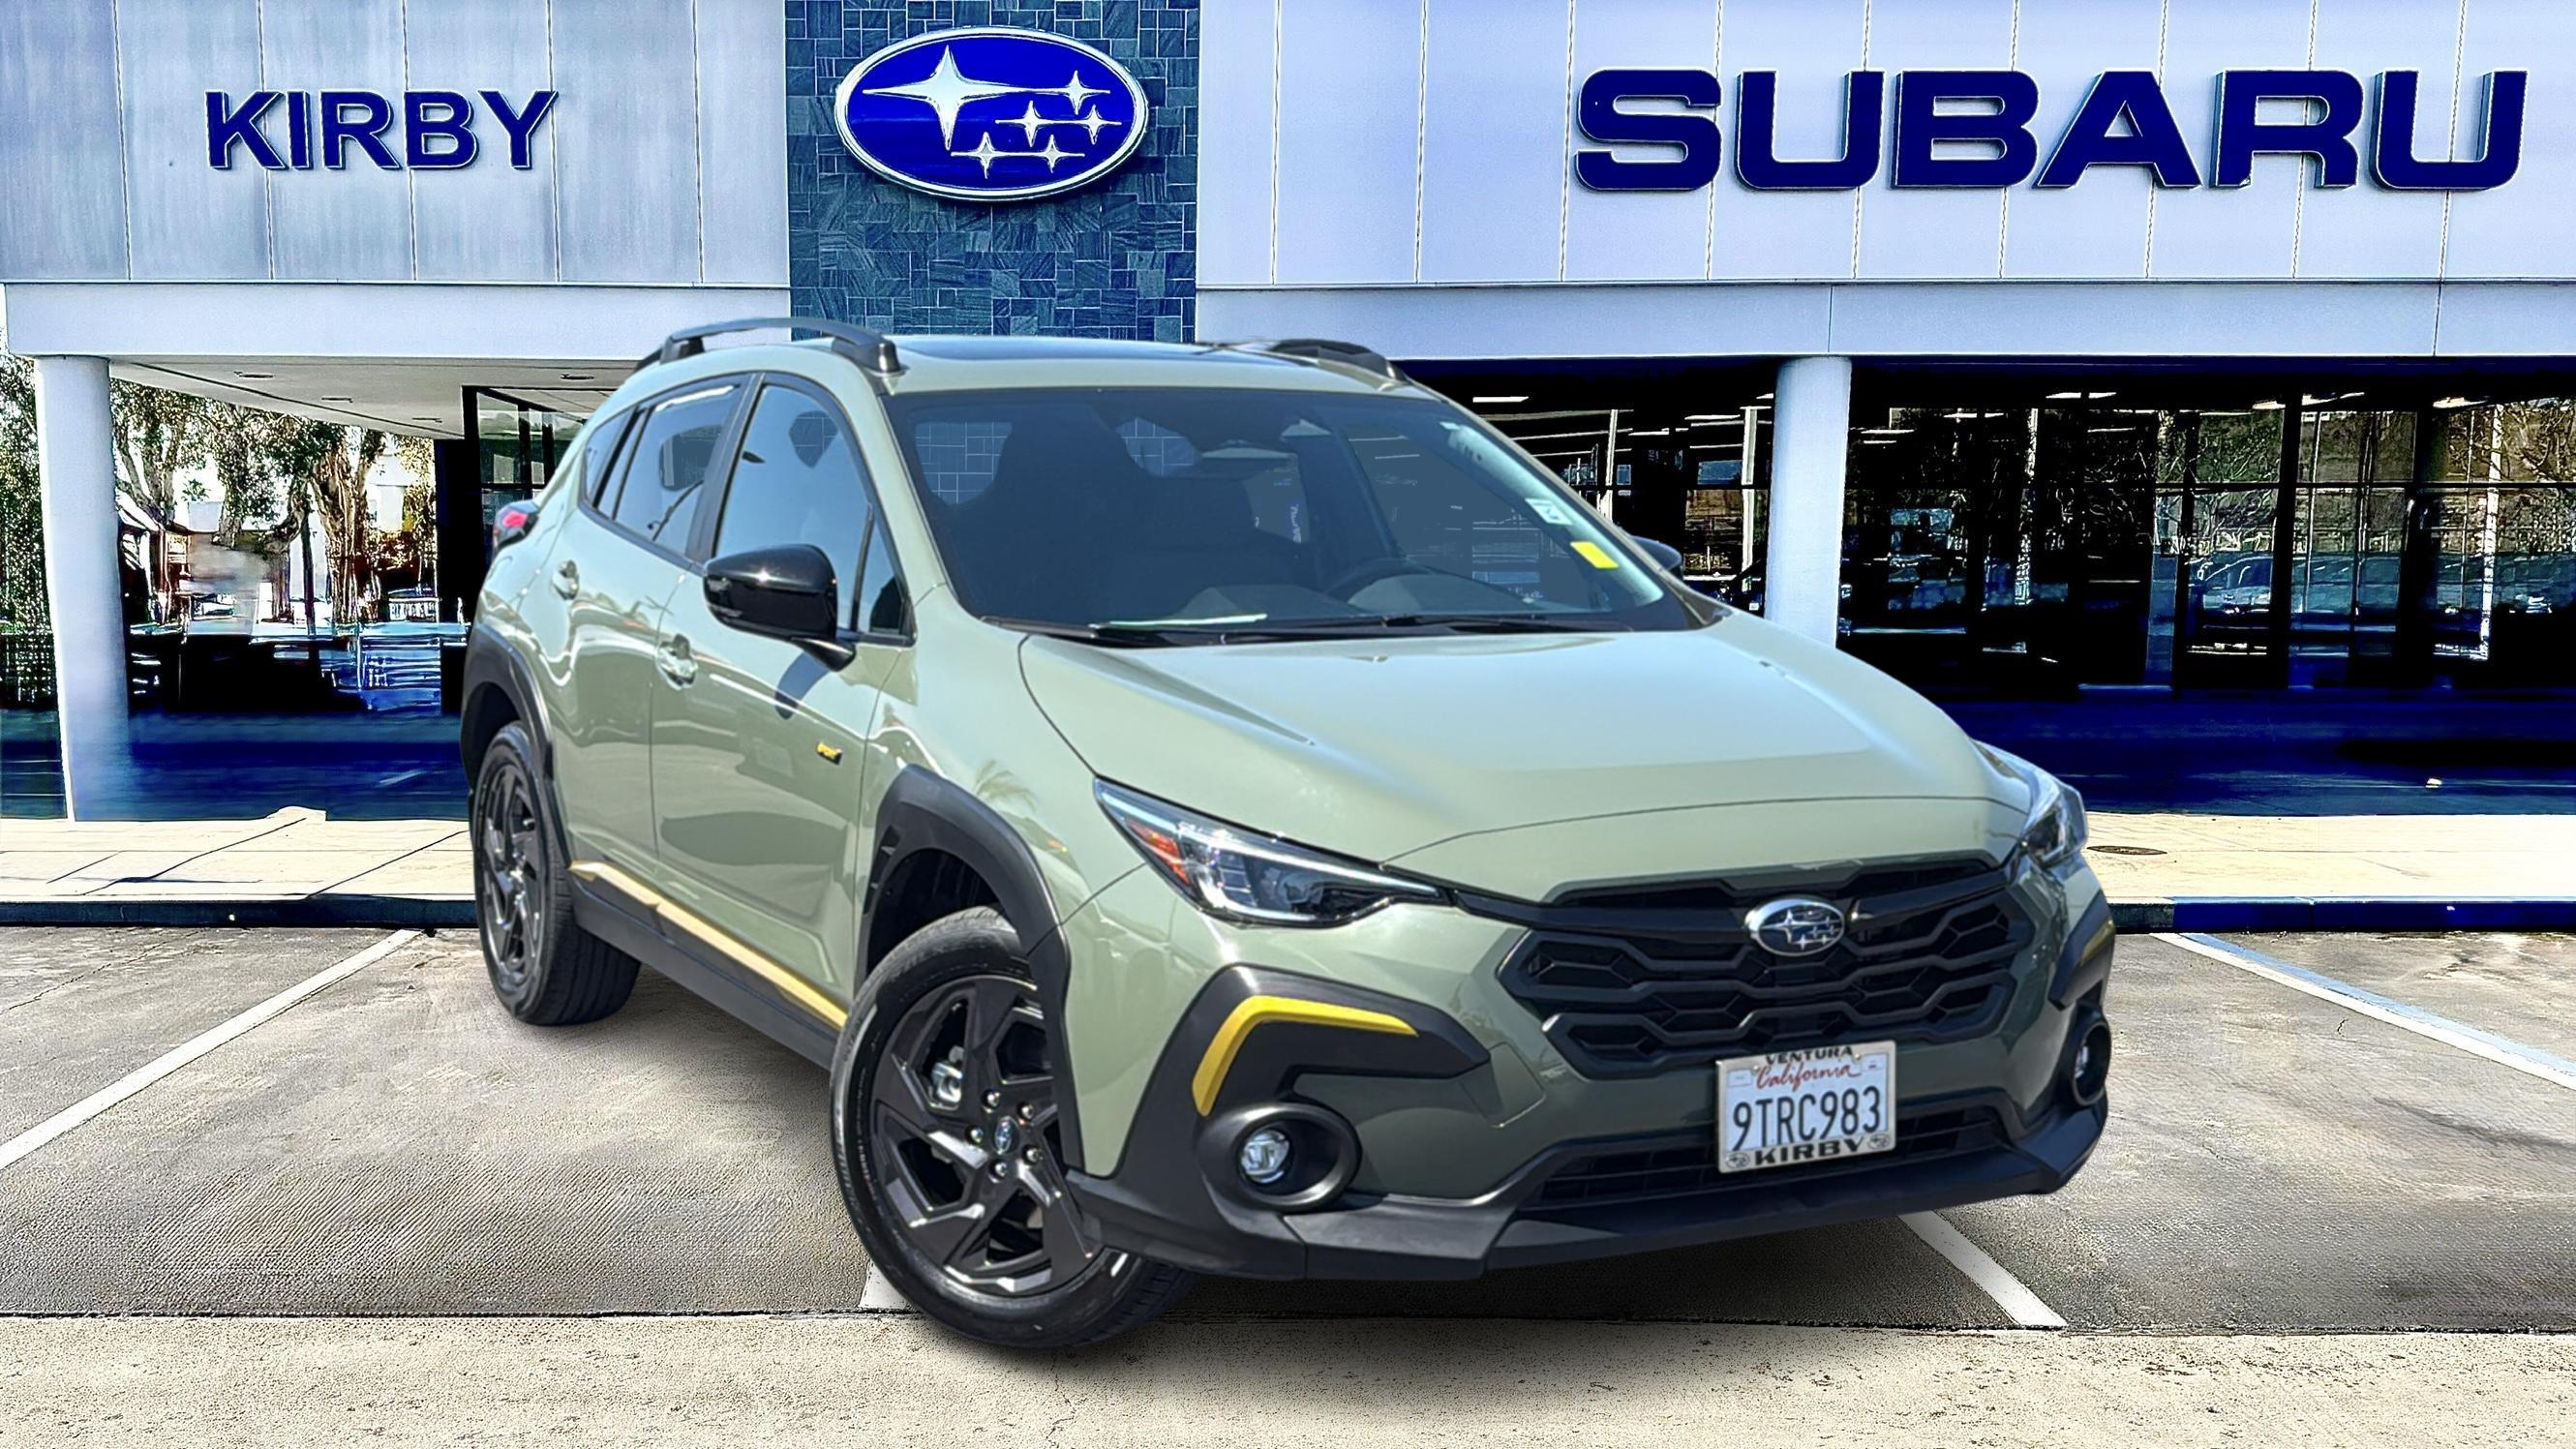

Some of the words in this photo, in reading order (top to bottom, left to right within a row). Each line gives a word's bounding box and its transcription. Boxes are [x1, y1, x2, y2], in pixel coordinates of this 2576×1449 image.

[204, 90, 559, 170] KIRBY
[1574, 70, 2528, 191] SUBARU
[1755, 1062, 1862, 1092] California
[1765, 1045, 1854, 1065] VENTURA
[1732, 1085, 1881, 1152] 9TRC983
[1754, 1136, 1864, 1166] KIRBY
